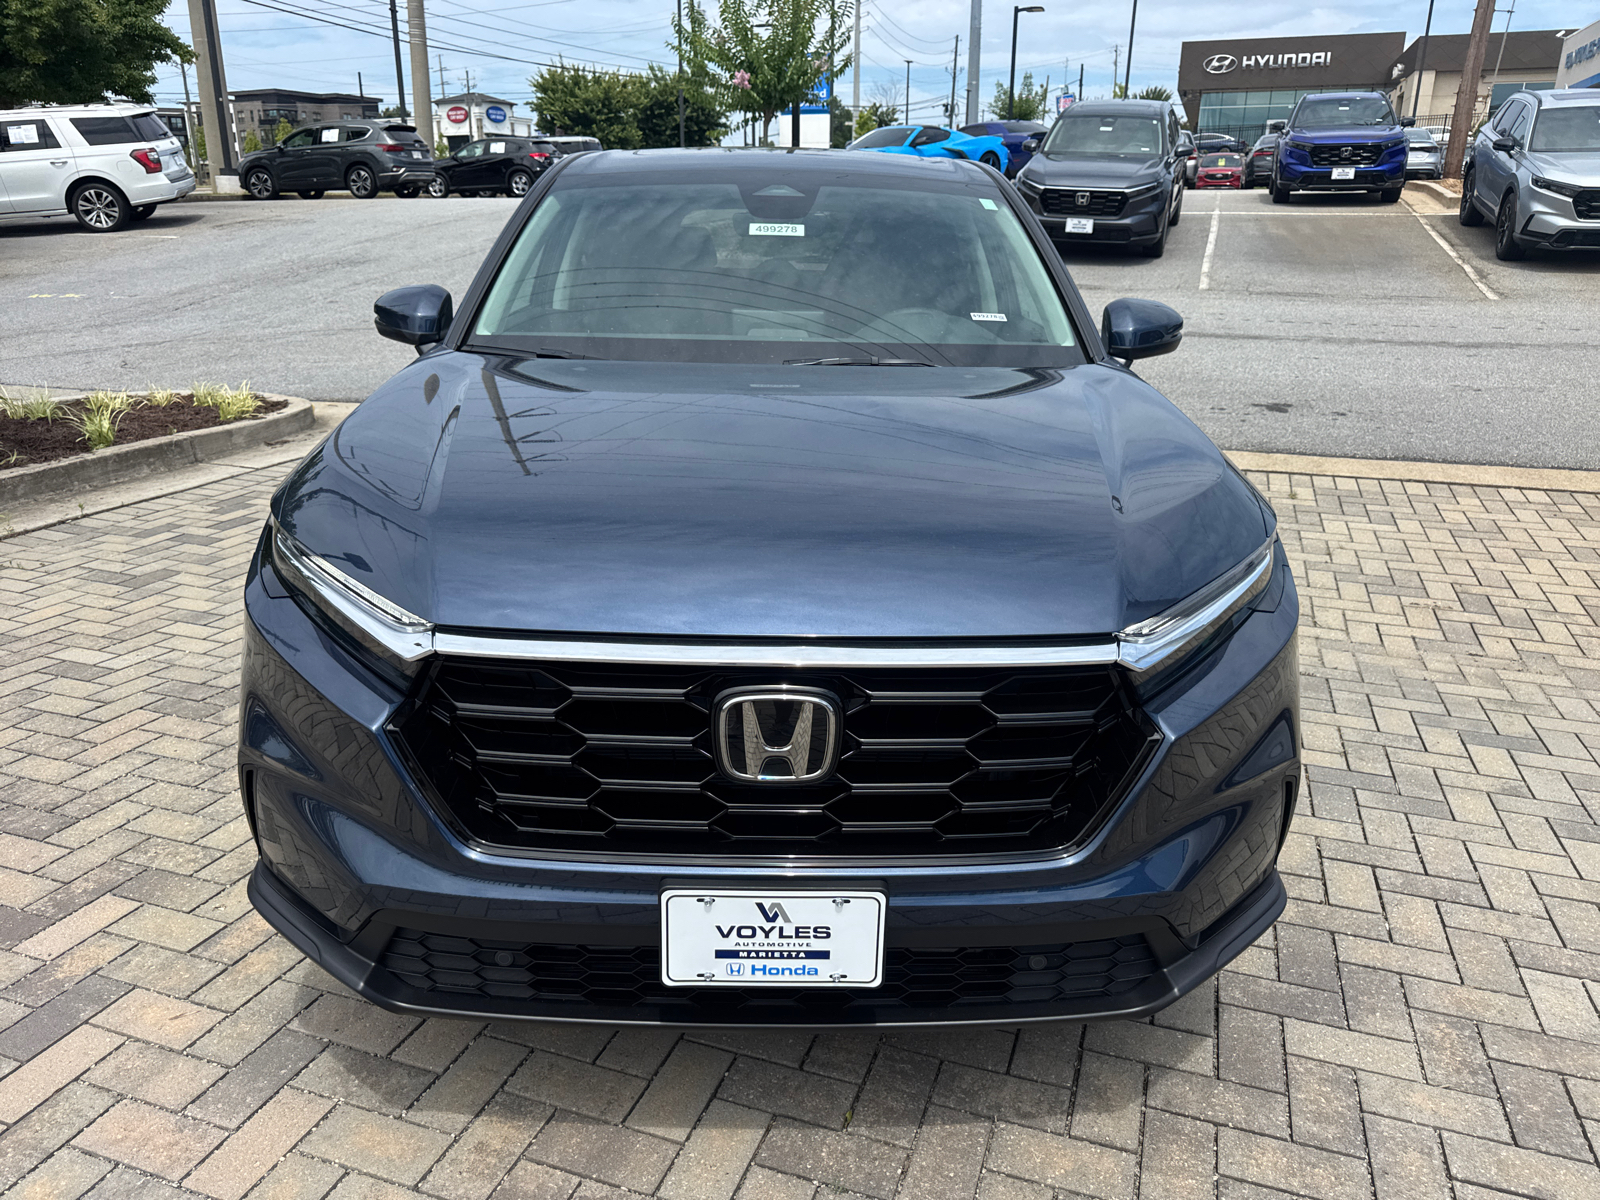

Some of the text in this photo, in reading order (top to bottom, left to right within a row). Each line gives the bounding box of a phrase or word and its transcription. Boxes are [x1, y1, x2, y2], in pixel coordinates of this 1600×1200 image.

[1241, 51, 1332, 70] HYUNDAI
[755, 225, 798, 233] 499278
[715, 925, 832, 939] VOYLES
[751, 964, 819, 976] Honda
